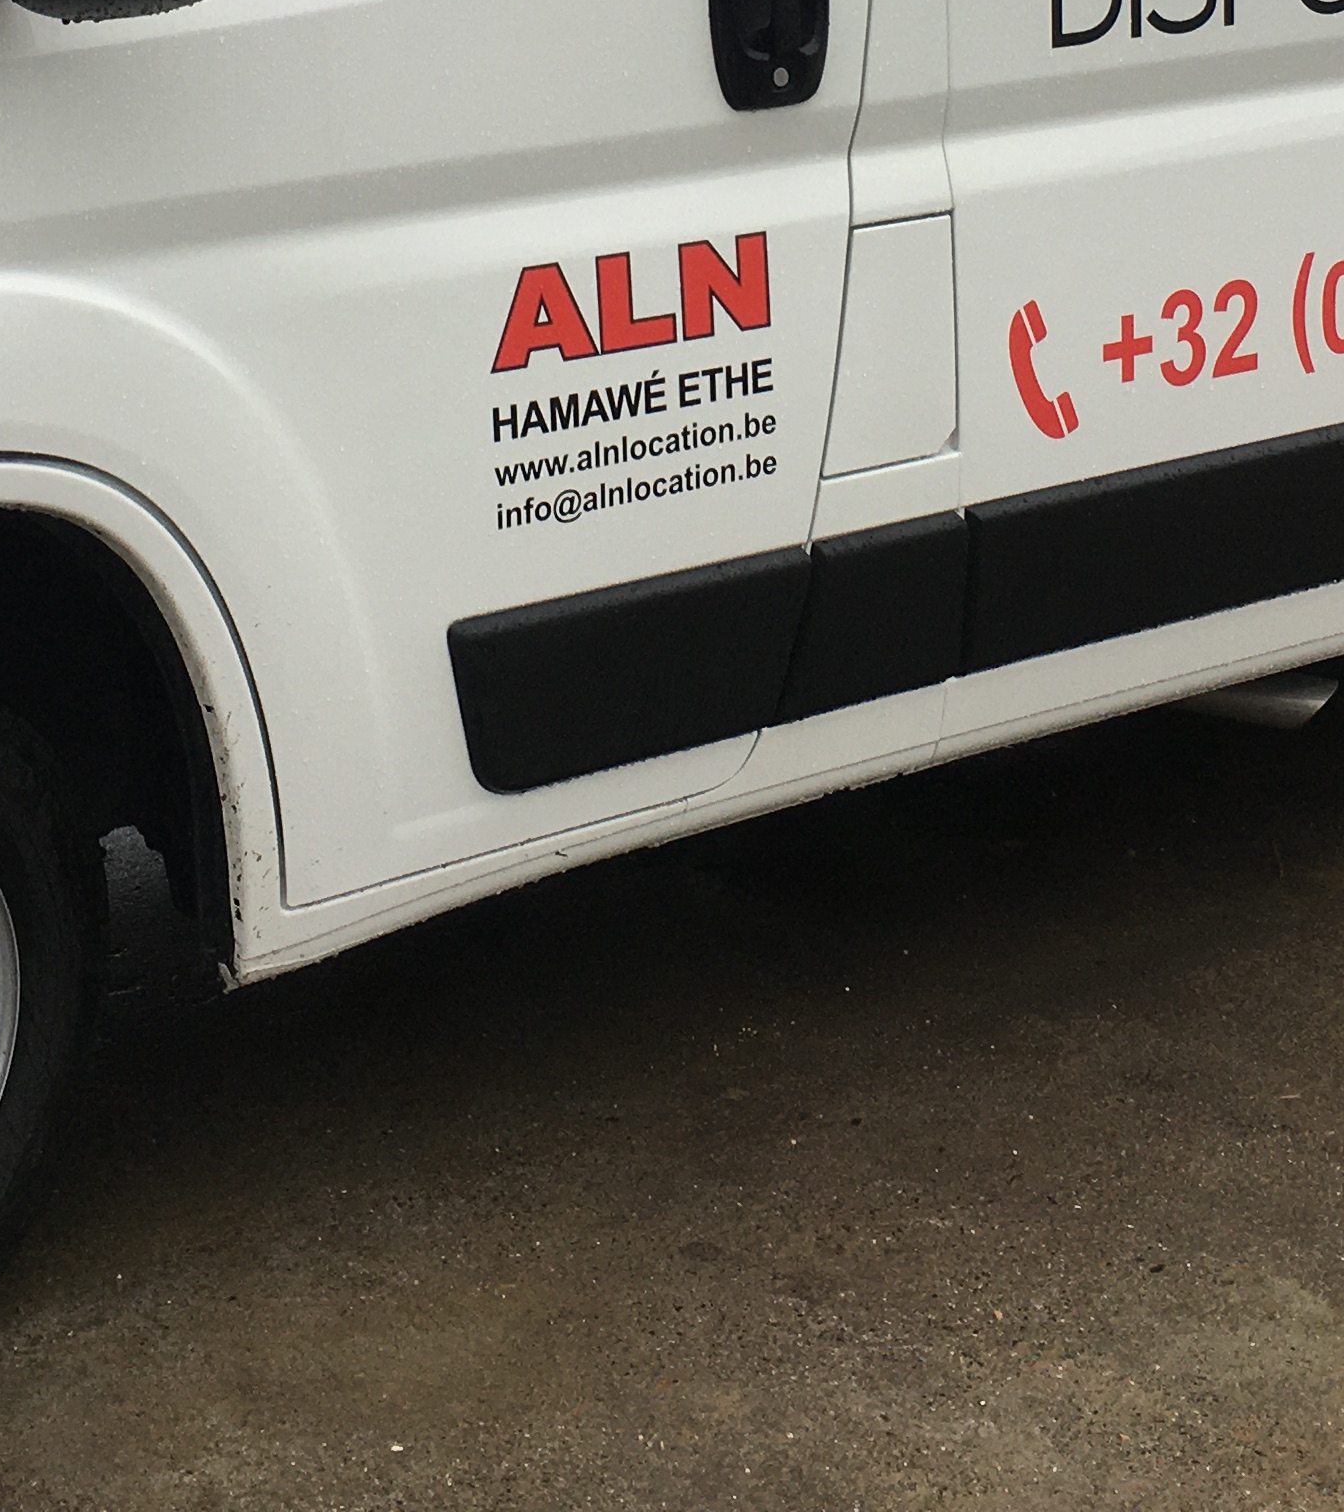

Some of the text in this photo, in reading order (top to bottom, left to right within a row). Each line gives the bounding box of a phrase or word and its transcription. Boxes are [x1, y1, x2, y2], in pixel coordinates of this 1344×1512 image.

[490, 230, 772, 374] ALN
[1102, 278, 1259, 388] +32
[492, 357, 774, 443] HAMAWÉ ETHE
[494, 412, 777, 487] www.alnlocation.be
[497, 453, 777, 530] info@alnlocation.be
